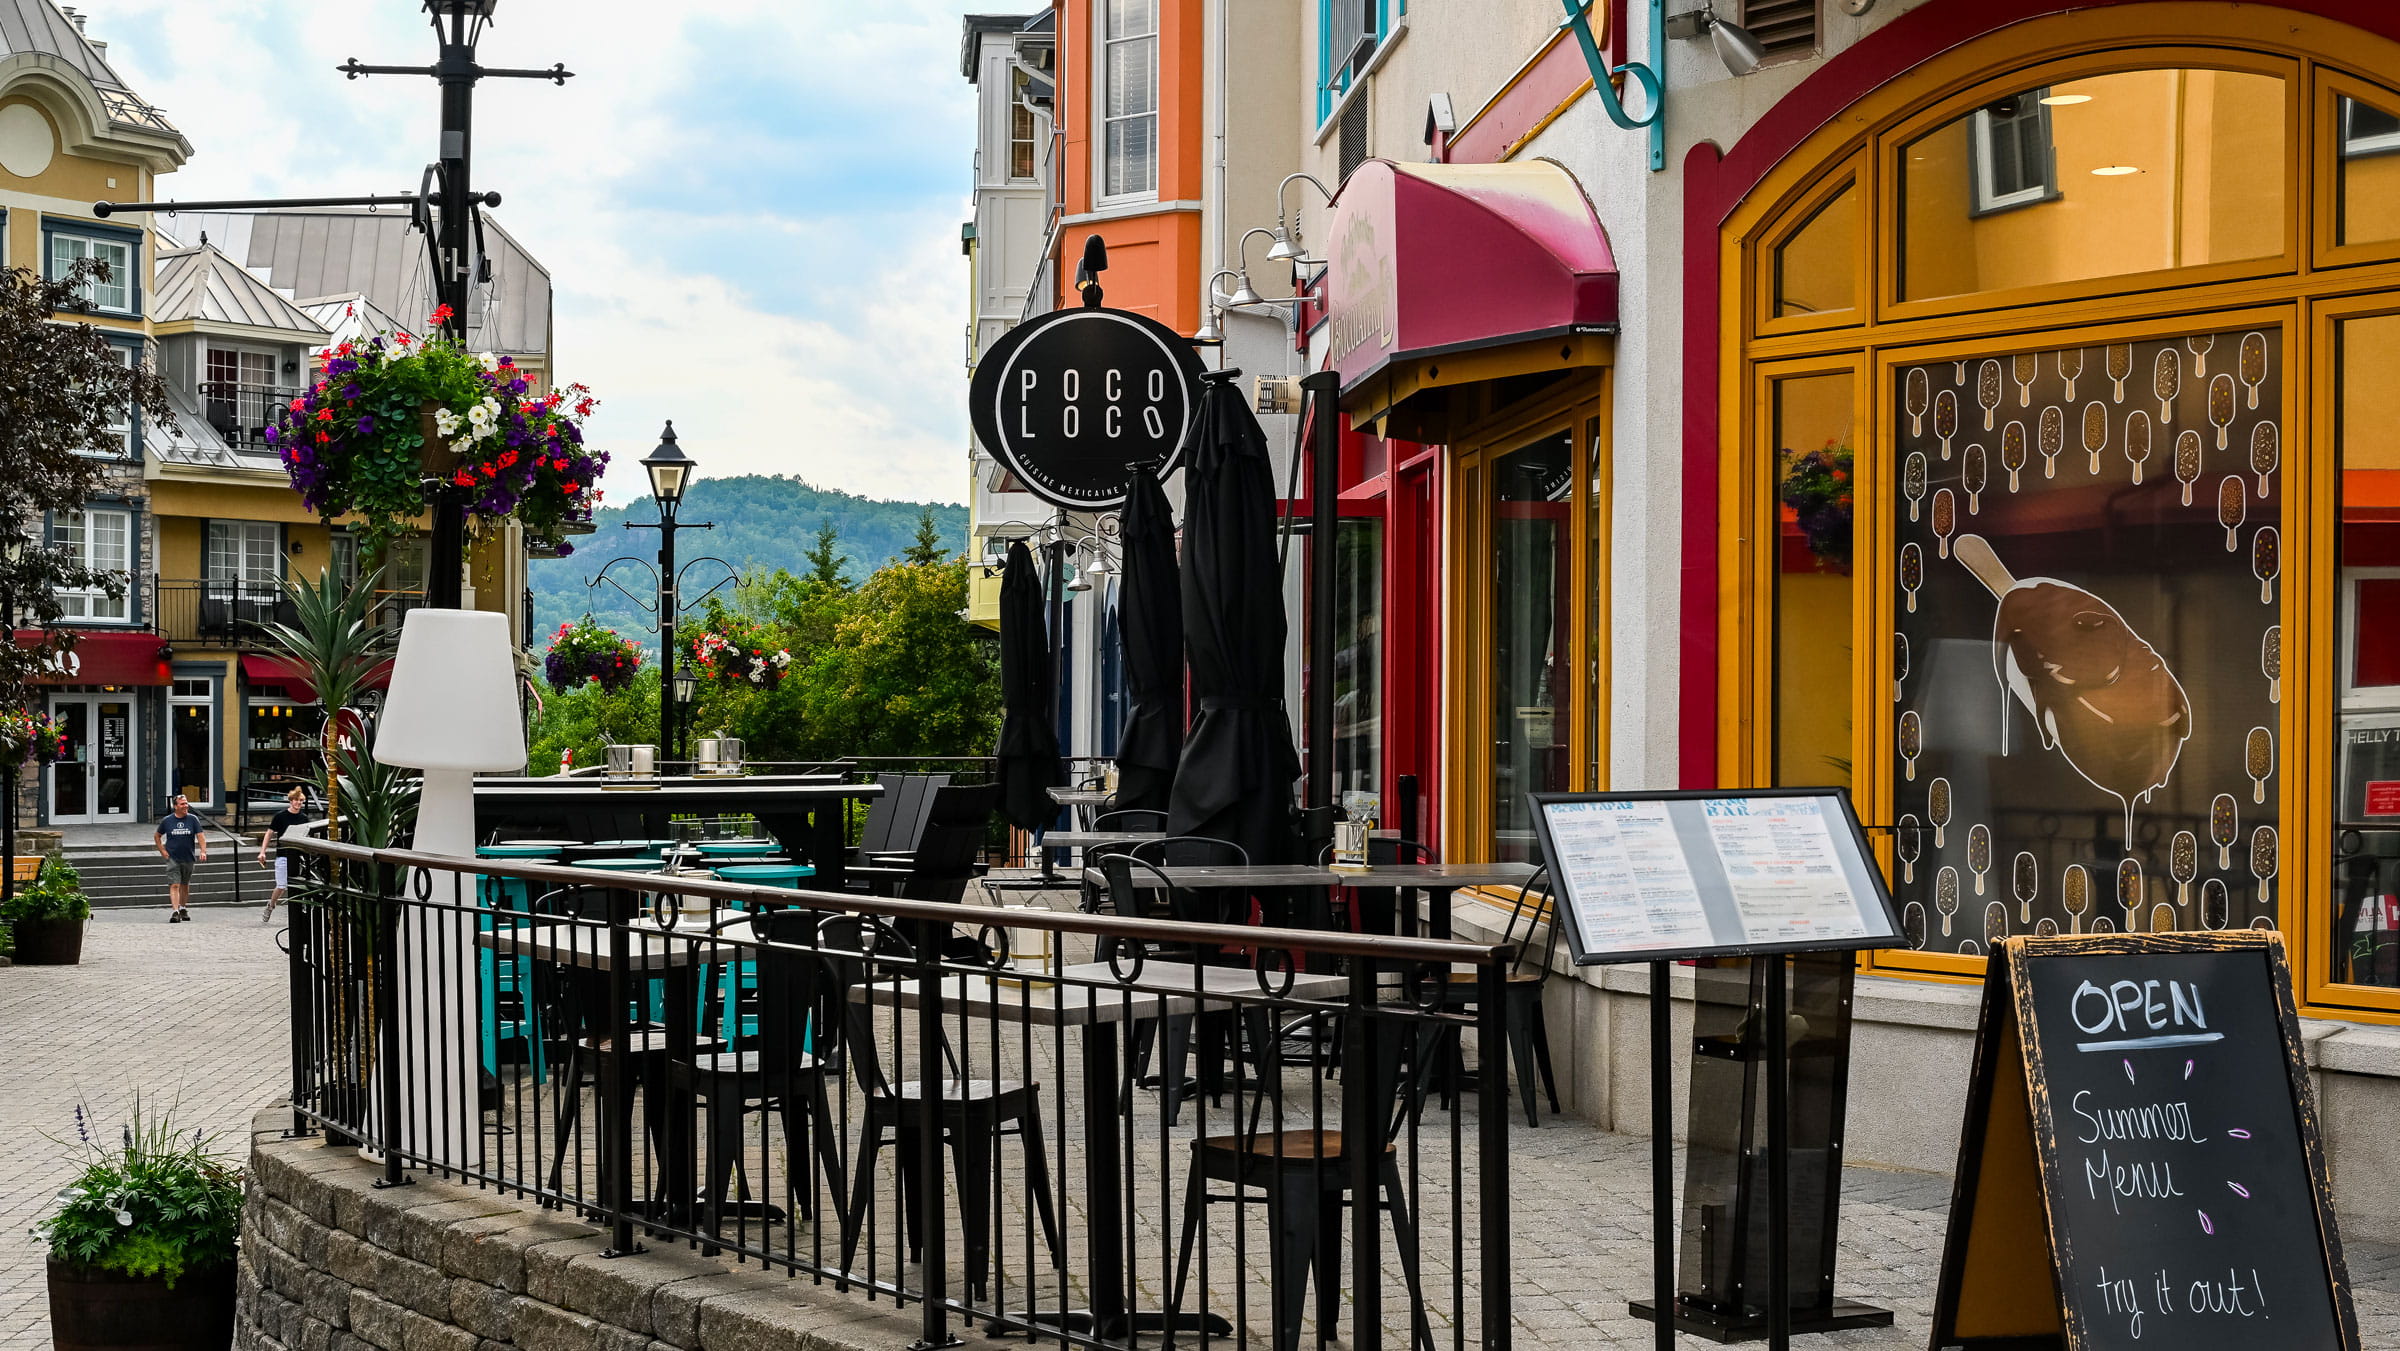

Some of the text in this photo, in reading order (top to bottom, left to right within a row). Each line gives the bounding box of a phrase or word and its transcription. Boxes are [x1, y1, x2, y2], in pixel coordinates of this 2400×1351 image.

[1021, 368, 1164, 402] POCO
[1021, 405, 1165, 439] LOCO
[1018, 453, 1120, 497] CUISINE MEXICAINE
[1707, 806, 1750, 816] BAR
[2071, 979, 2208, 1034] OPEN
[2072, 1090, 2208, 1143] Summer
[2085, 1148, 2185, 1215] Menu
[2096, 1265, 2270, 1340] try it out!
